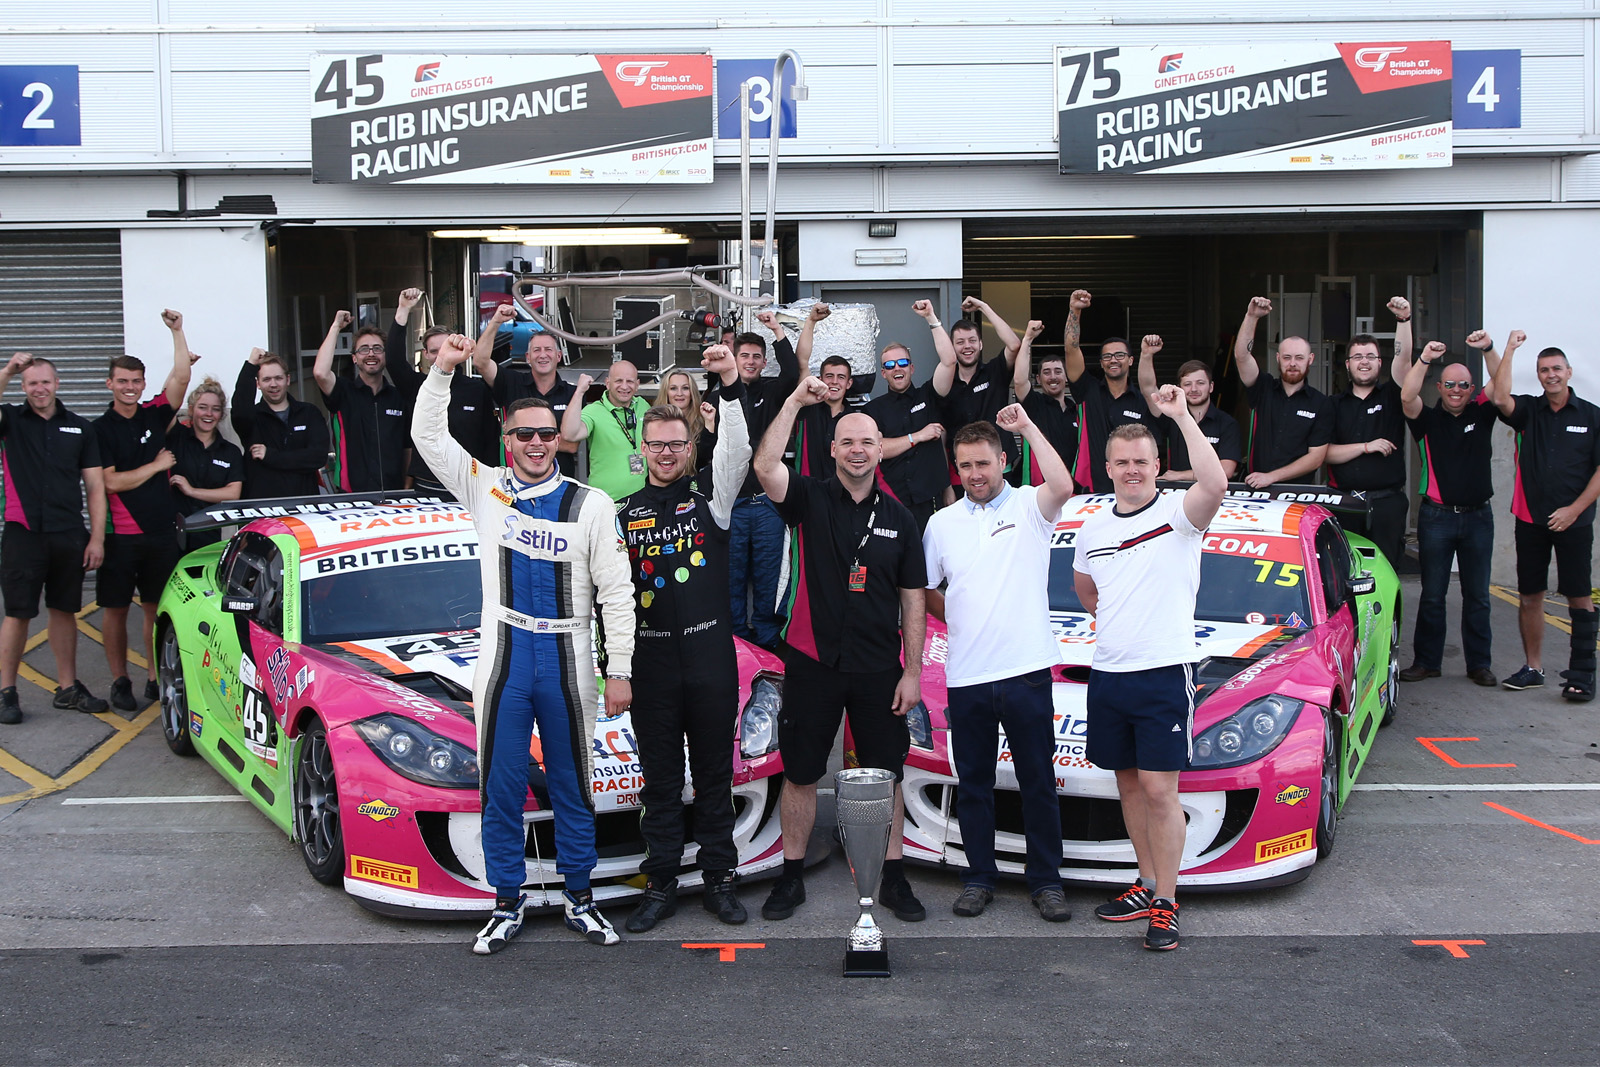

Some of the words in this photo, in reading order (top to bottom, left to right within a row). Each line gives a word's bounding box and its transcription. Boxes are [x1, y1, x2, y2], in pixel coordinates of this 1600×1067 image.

[1061, 47, 1121, 106] 75
[1390, 60, 1416, 68] British
[1390, 67, 1443, 76] Championship
[314, 54, 384, 110] 45
[410, 83, 453, 98] GINETTA
[454, 80, 472, 91] G55
[474, 76, 494, 87] GT4
[650, 75, 677, 83] British
[679, 75, 691, 83] GT
[650, 84, 704, 92] Championship
[1154, 74, 1196, 89] GINETTA
[1197, 70, 1215, 82] G55
[1216, 65, 1235, 77] GT4
[1467, 66, 1500, 112] 4
[22, 82, 55, 129] 2
[745, 76, 773, 122] 3
[1097, 103, 1160, 139] RCIB
[1165, 69, 1328, 126] INSURANCE
[351, 112, 416, 148] RCIB
[421, 82, 588, 136] INSURANCE
[1371, 126, 1447, 147] BRITISHGT.COM
[351, 138, 460, 180] RACING
[631, 143, 707, 161] BRITISHGT.COM
[1097, 127, 1203, 172] RACING
[516, 529, 568, 556] stilp
[629, 533, 705, 562] plastic
[1253, 559, 1304, 587] 75
[639, 630, 671, 638] William
[683, 619, 717, 636] Phillips
[407, 633, 482, 654] 45
[244, 690, 267, 744] 45
[1276, 788, 1309, 803] SUNOCO
[358, 804, 400, 817] SUNOCO
[1260, 833, 1307, 858] PIRELLI
[356, 859, 412, 884] PIRELLI
